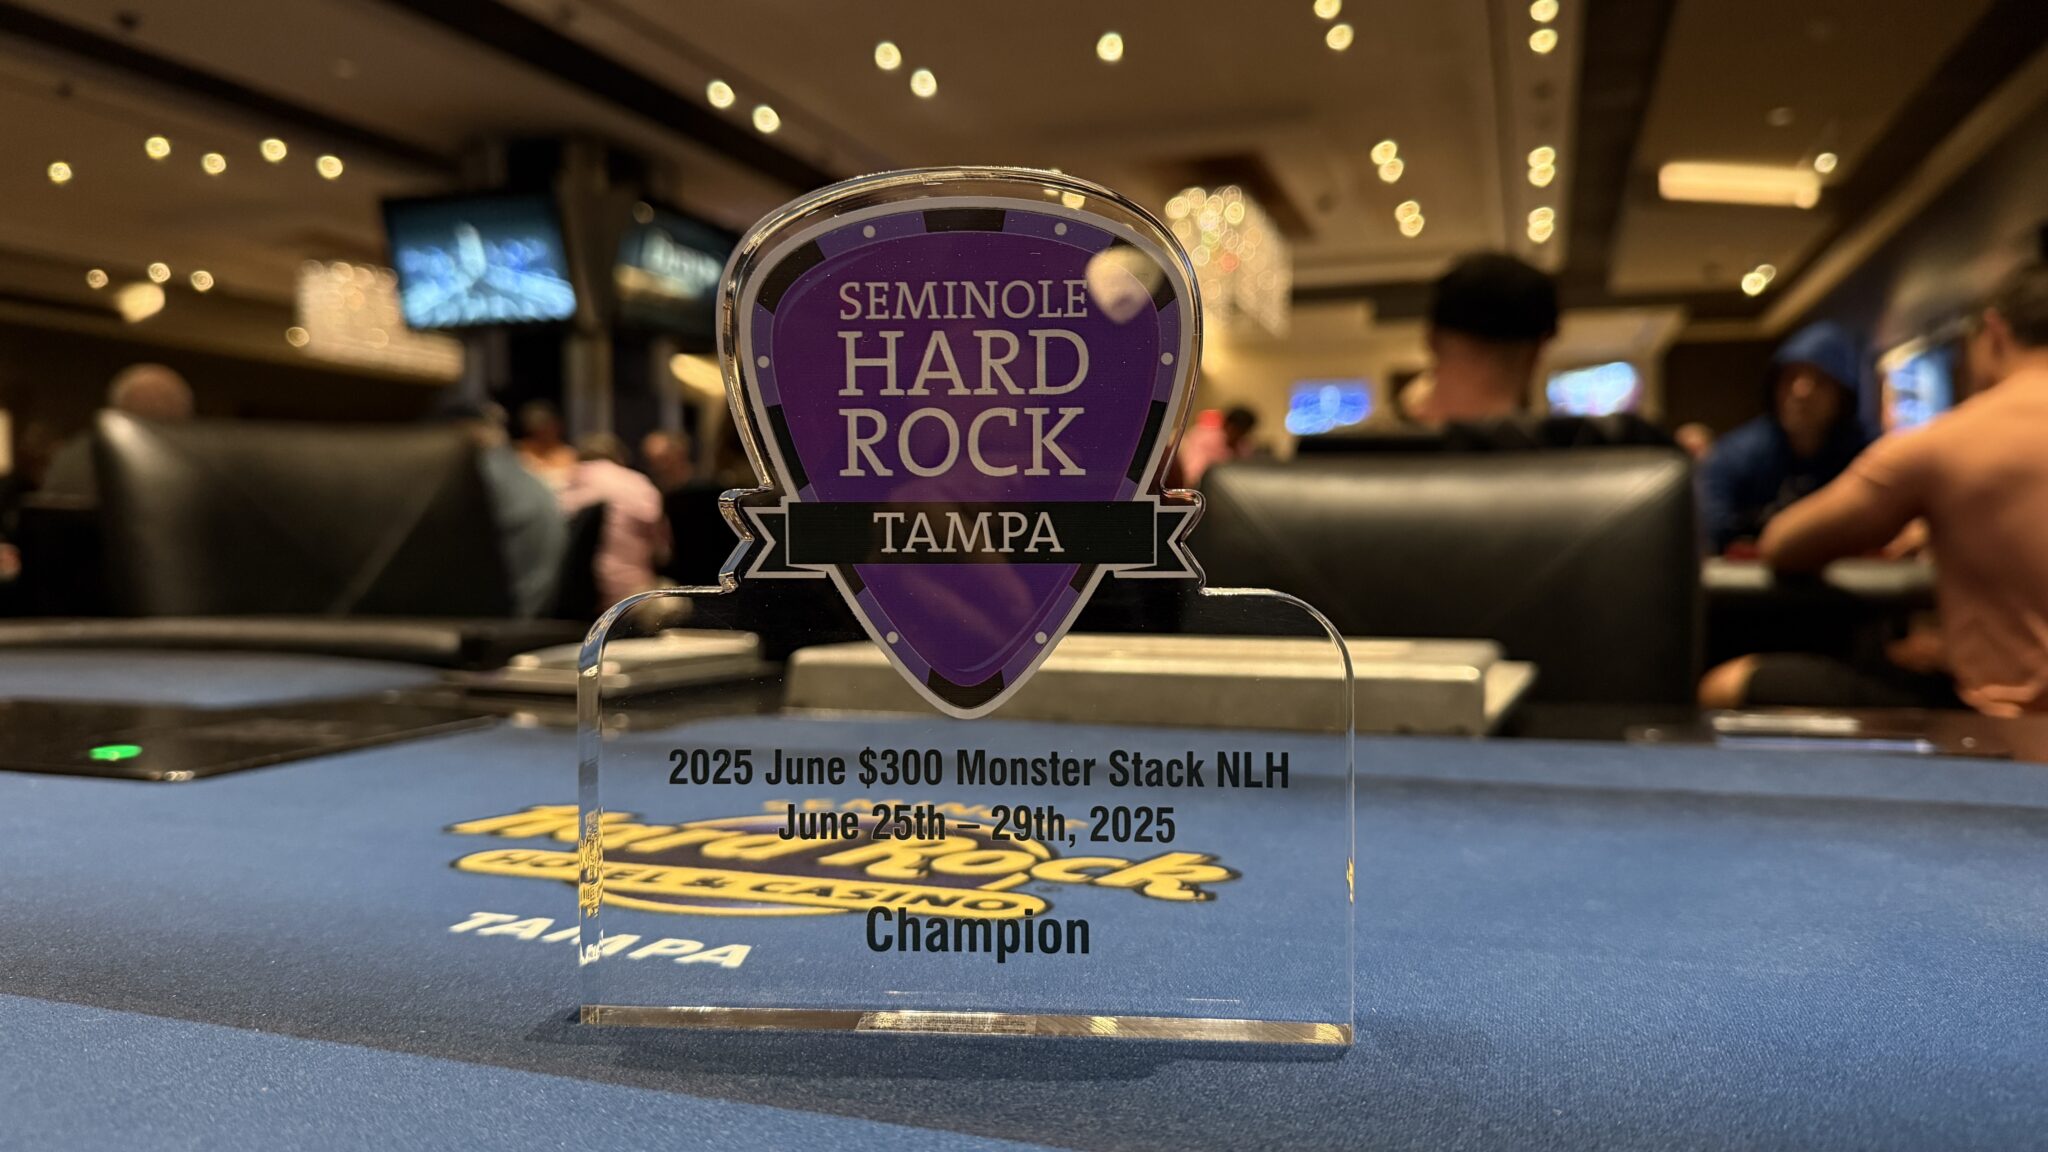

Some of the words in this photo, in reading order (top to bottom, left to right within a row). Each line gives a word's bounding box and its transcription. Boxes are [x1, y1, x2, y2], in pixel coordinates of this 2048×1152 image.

[838, 279, 1088, 321] SEMINOLE
[837, 328, 1090, 397] HARD
[838, 407, 1086, 478] ROCK
[873, 511, 1065, 553] TAMPA
[668, 748, 753, 785] 2025
[765, 748, 846, 785] June
[858, 746, 943, 789] $300
[956, 749, 1096, 787] Monster
[1108, 749, 1205, 788] Stack
[1217, 751, 1289, 788] NLH
[778, 803, 859, 841] June
[871, 803, 947, 841] 25th
[991, 804, 1077, 848] 29th,
[1090, 805, 1176, 843] 2025
[480, 850, 669, 884] HOEL
[748, 880, 1021, 912] CASINO
[816, 830, 1232, 902] Rock
[449, 911, 753, 969] TAMPA
[866, 905, 1090, 964] Champion
